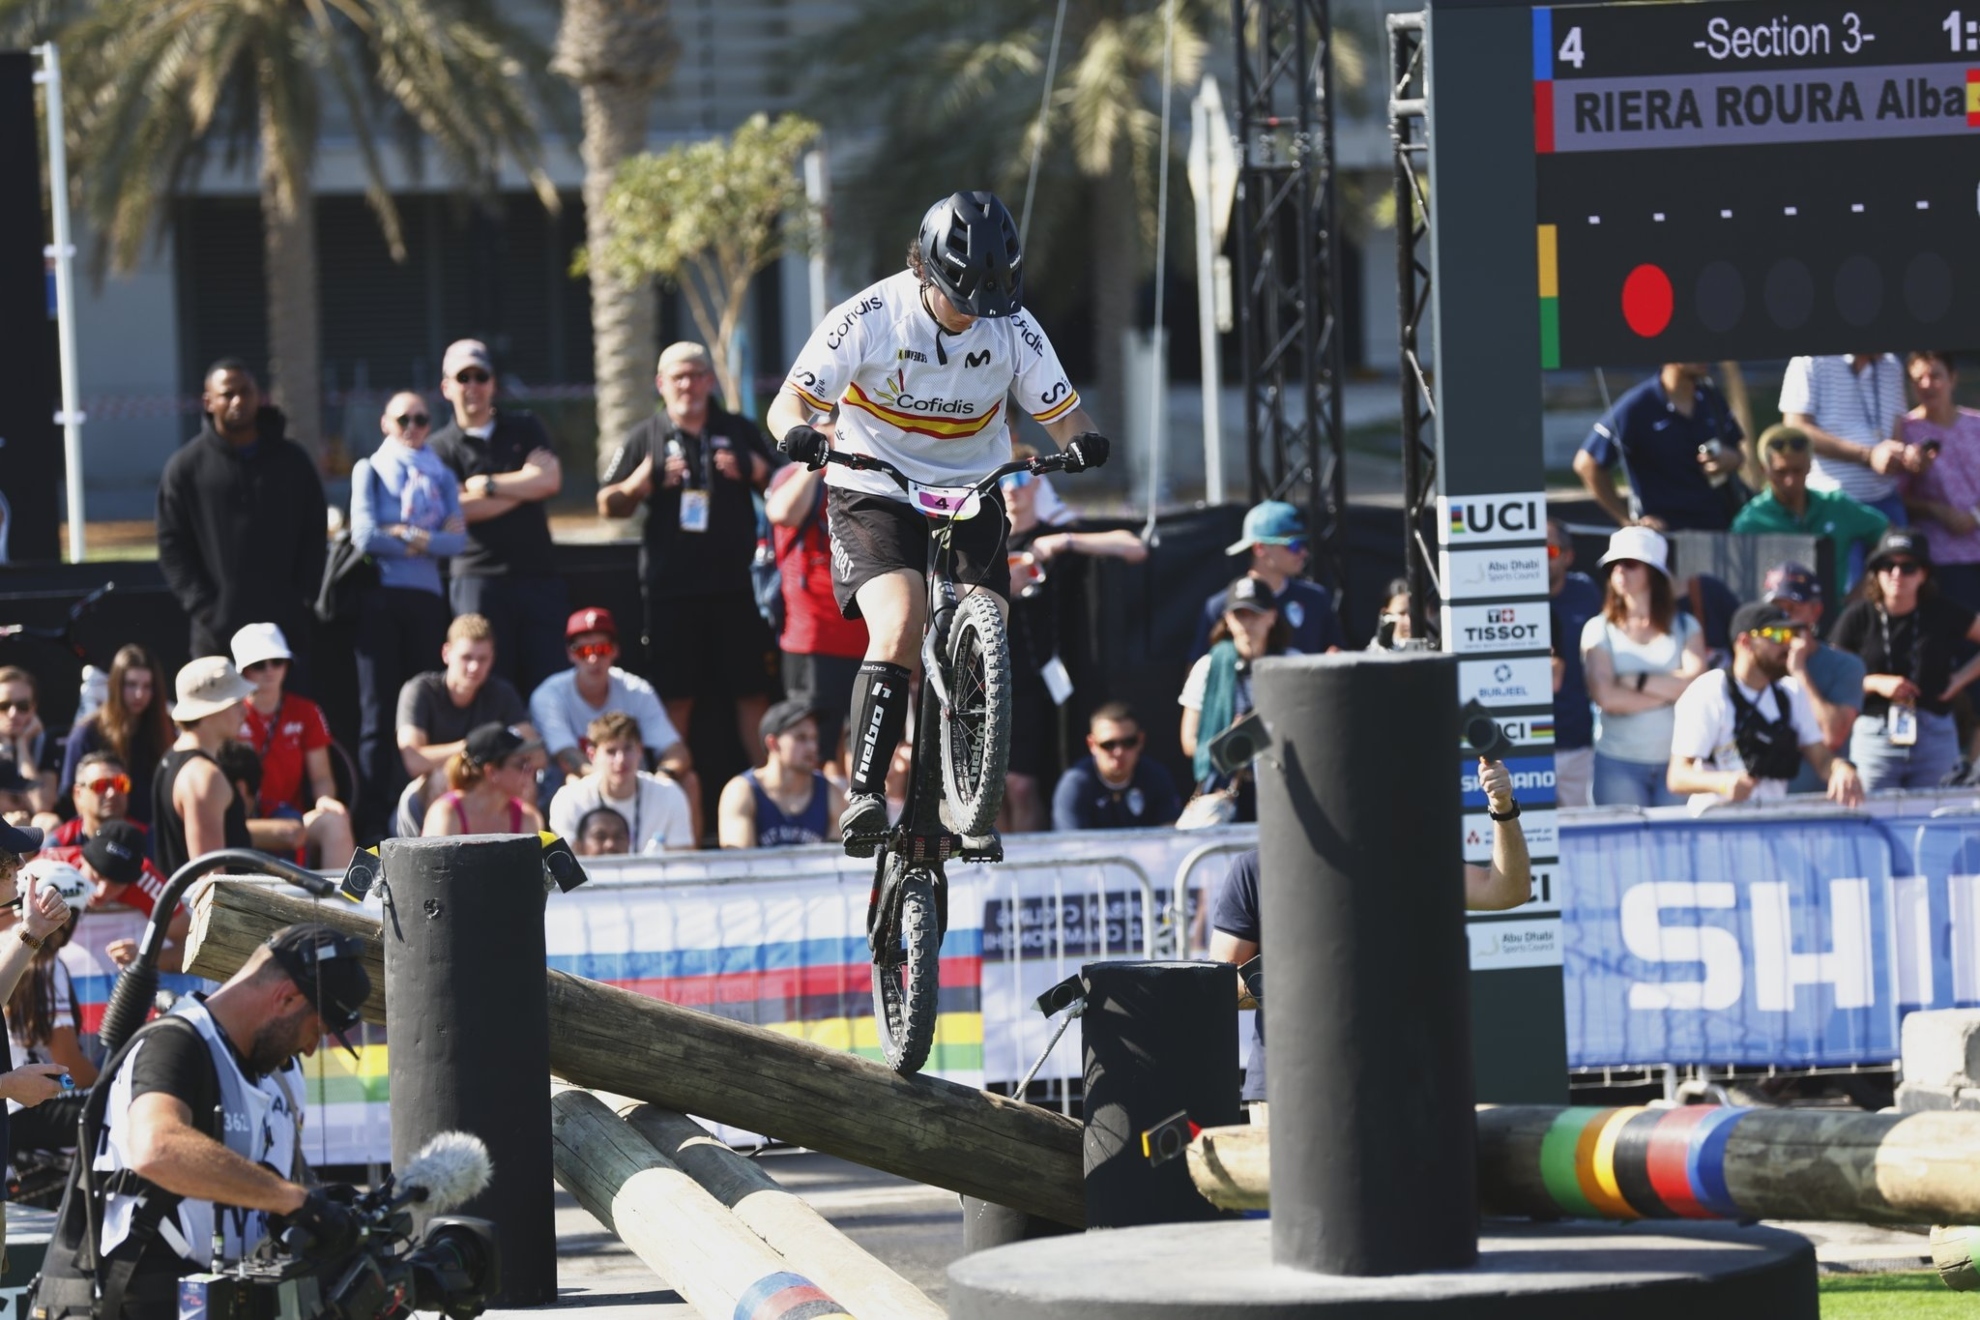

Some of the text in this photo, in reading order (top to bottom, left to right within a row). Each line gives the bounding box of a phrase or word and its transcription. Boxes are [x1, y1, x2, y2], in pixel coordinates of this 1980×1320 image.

[1693, 12, 1875, 60] -Section 3-
[1942, 10, 1980, 52] 1:
[1558, 26, 1585, 68] 4
[1574, 76, 1967, 133] RIERA ROURA Alba
[897, 394, 974, 414] Cofidis
[935, 497, 949, 510] 4
[1467, 501, 1536, 533] UCI
[1488, 558, 1539, 571] Abu Dhabi
[1464, 624, 1539, 642] TISSOT
[1479, 686, 1529, 698] BURJEEL
[855, 704, 885, 784] hebo
[1497, 722, 1525, 744] CI
[1460, 770, 1556, 793] SANO
[1503, 930, 1553, 943] Abu Dhabi
